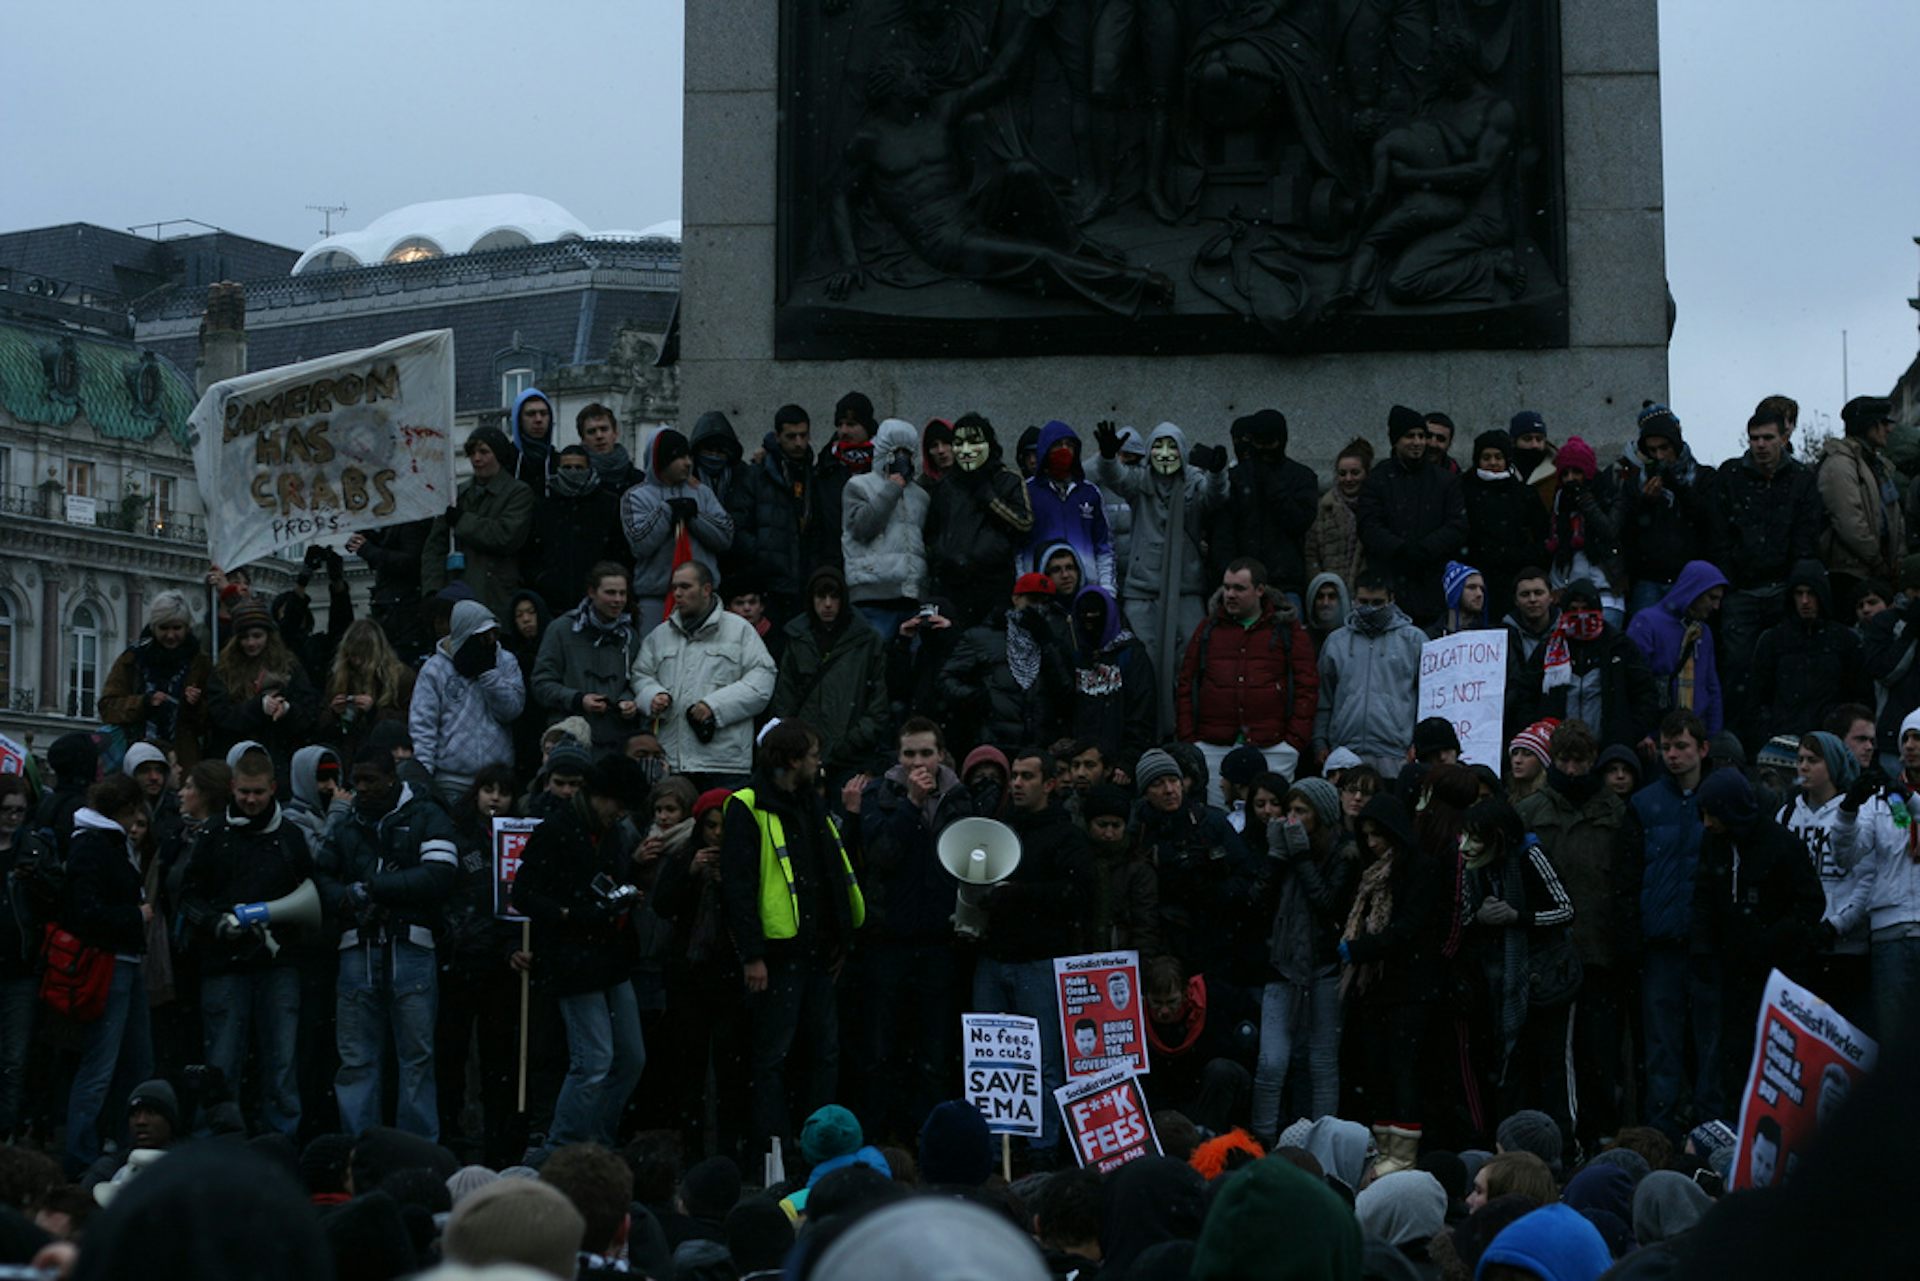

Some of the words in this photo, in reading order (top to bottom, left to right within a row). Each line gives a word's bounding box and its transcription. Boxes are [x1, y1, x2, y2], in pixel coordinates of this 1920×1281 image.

[256, 421, 335, 465] HAS
[251, 466, 397, 517] CRABS
[1422, 643, 1500, 676] EDUCATION
[1431, 686, 1446, 710] IS
[1452, 681, 1486, 704] NOT
[1065, 960, 1100, 970] Socialist
[1101, 957, 1128, 967] Worker
[971, 1028, 992, 1043] No
[997, 1028, 1034, 1047] fees,
[1103, 1020, 1134, 1034] BRING
[1103, 1032, 1135, 1045] DOWN
[1780, 990, 1823, 1035] Socialist
[1825, 1019, 1863, 1062] Worker
[975, 1048, 994, 1057] no
[999, 1046, 1031, 1060] cuts
[1105, 1044, 1123, 1056] THE
[969, 1071, 1038, 1097] SAVE
[1065, 1080, 1100, 1099] Socialist
[1100, 1071, 1124, 1088] Worker
[975, 1097, 1034, 1121] EMA
[1080, 1113, 1146, 1161] FEES
